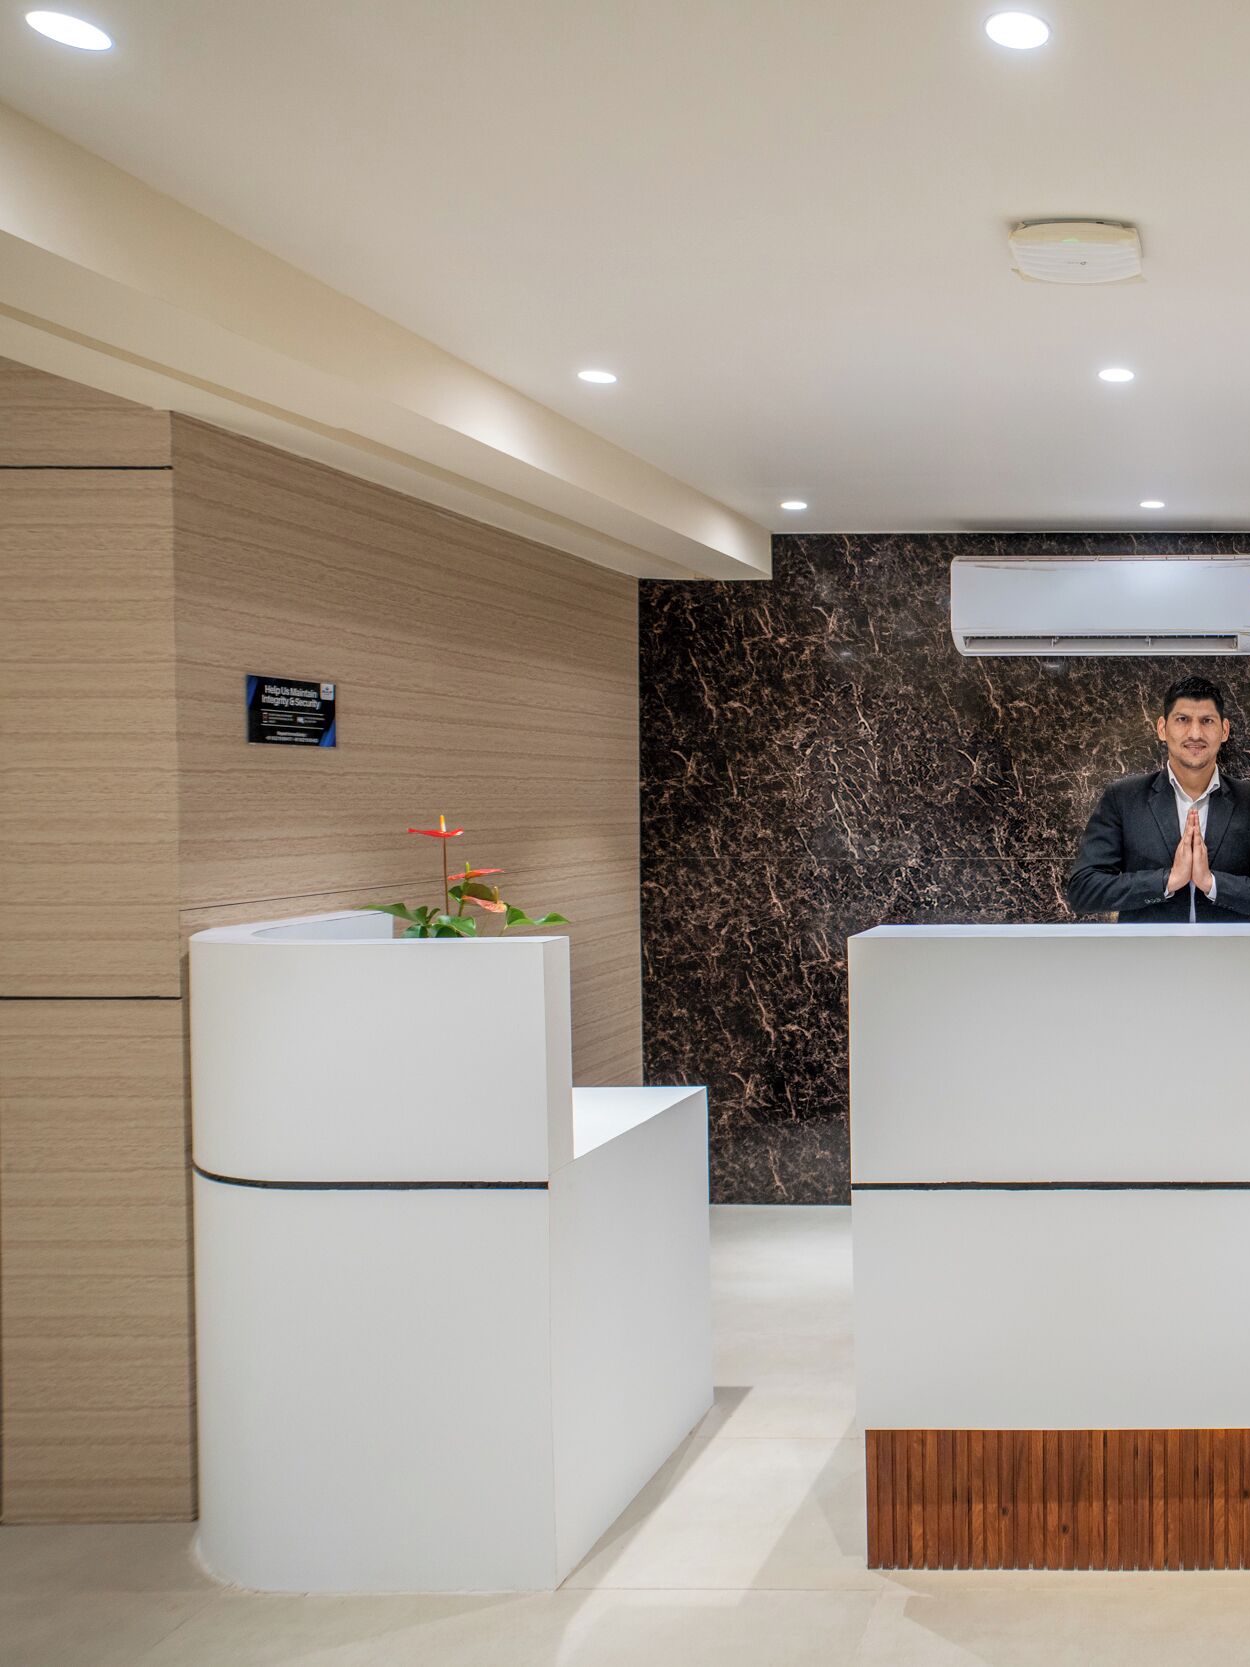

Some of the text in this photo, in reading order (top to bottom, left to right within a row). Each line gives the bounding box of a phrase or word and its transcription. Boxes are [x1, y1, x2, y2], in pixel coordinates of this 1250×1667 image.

[264, 685, 318, 698] Help Us Maintain
[261, 695, 321, 710] Integrity & Security
